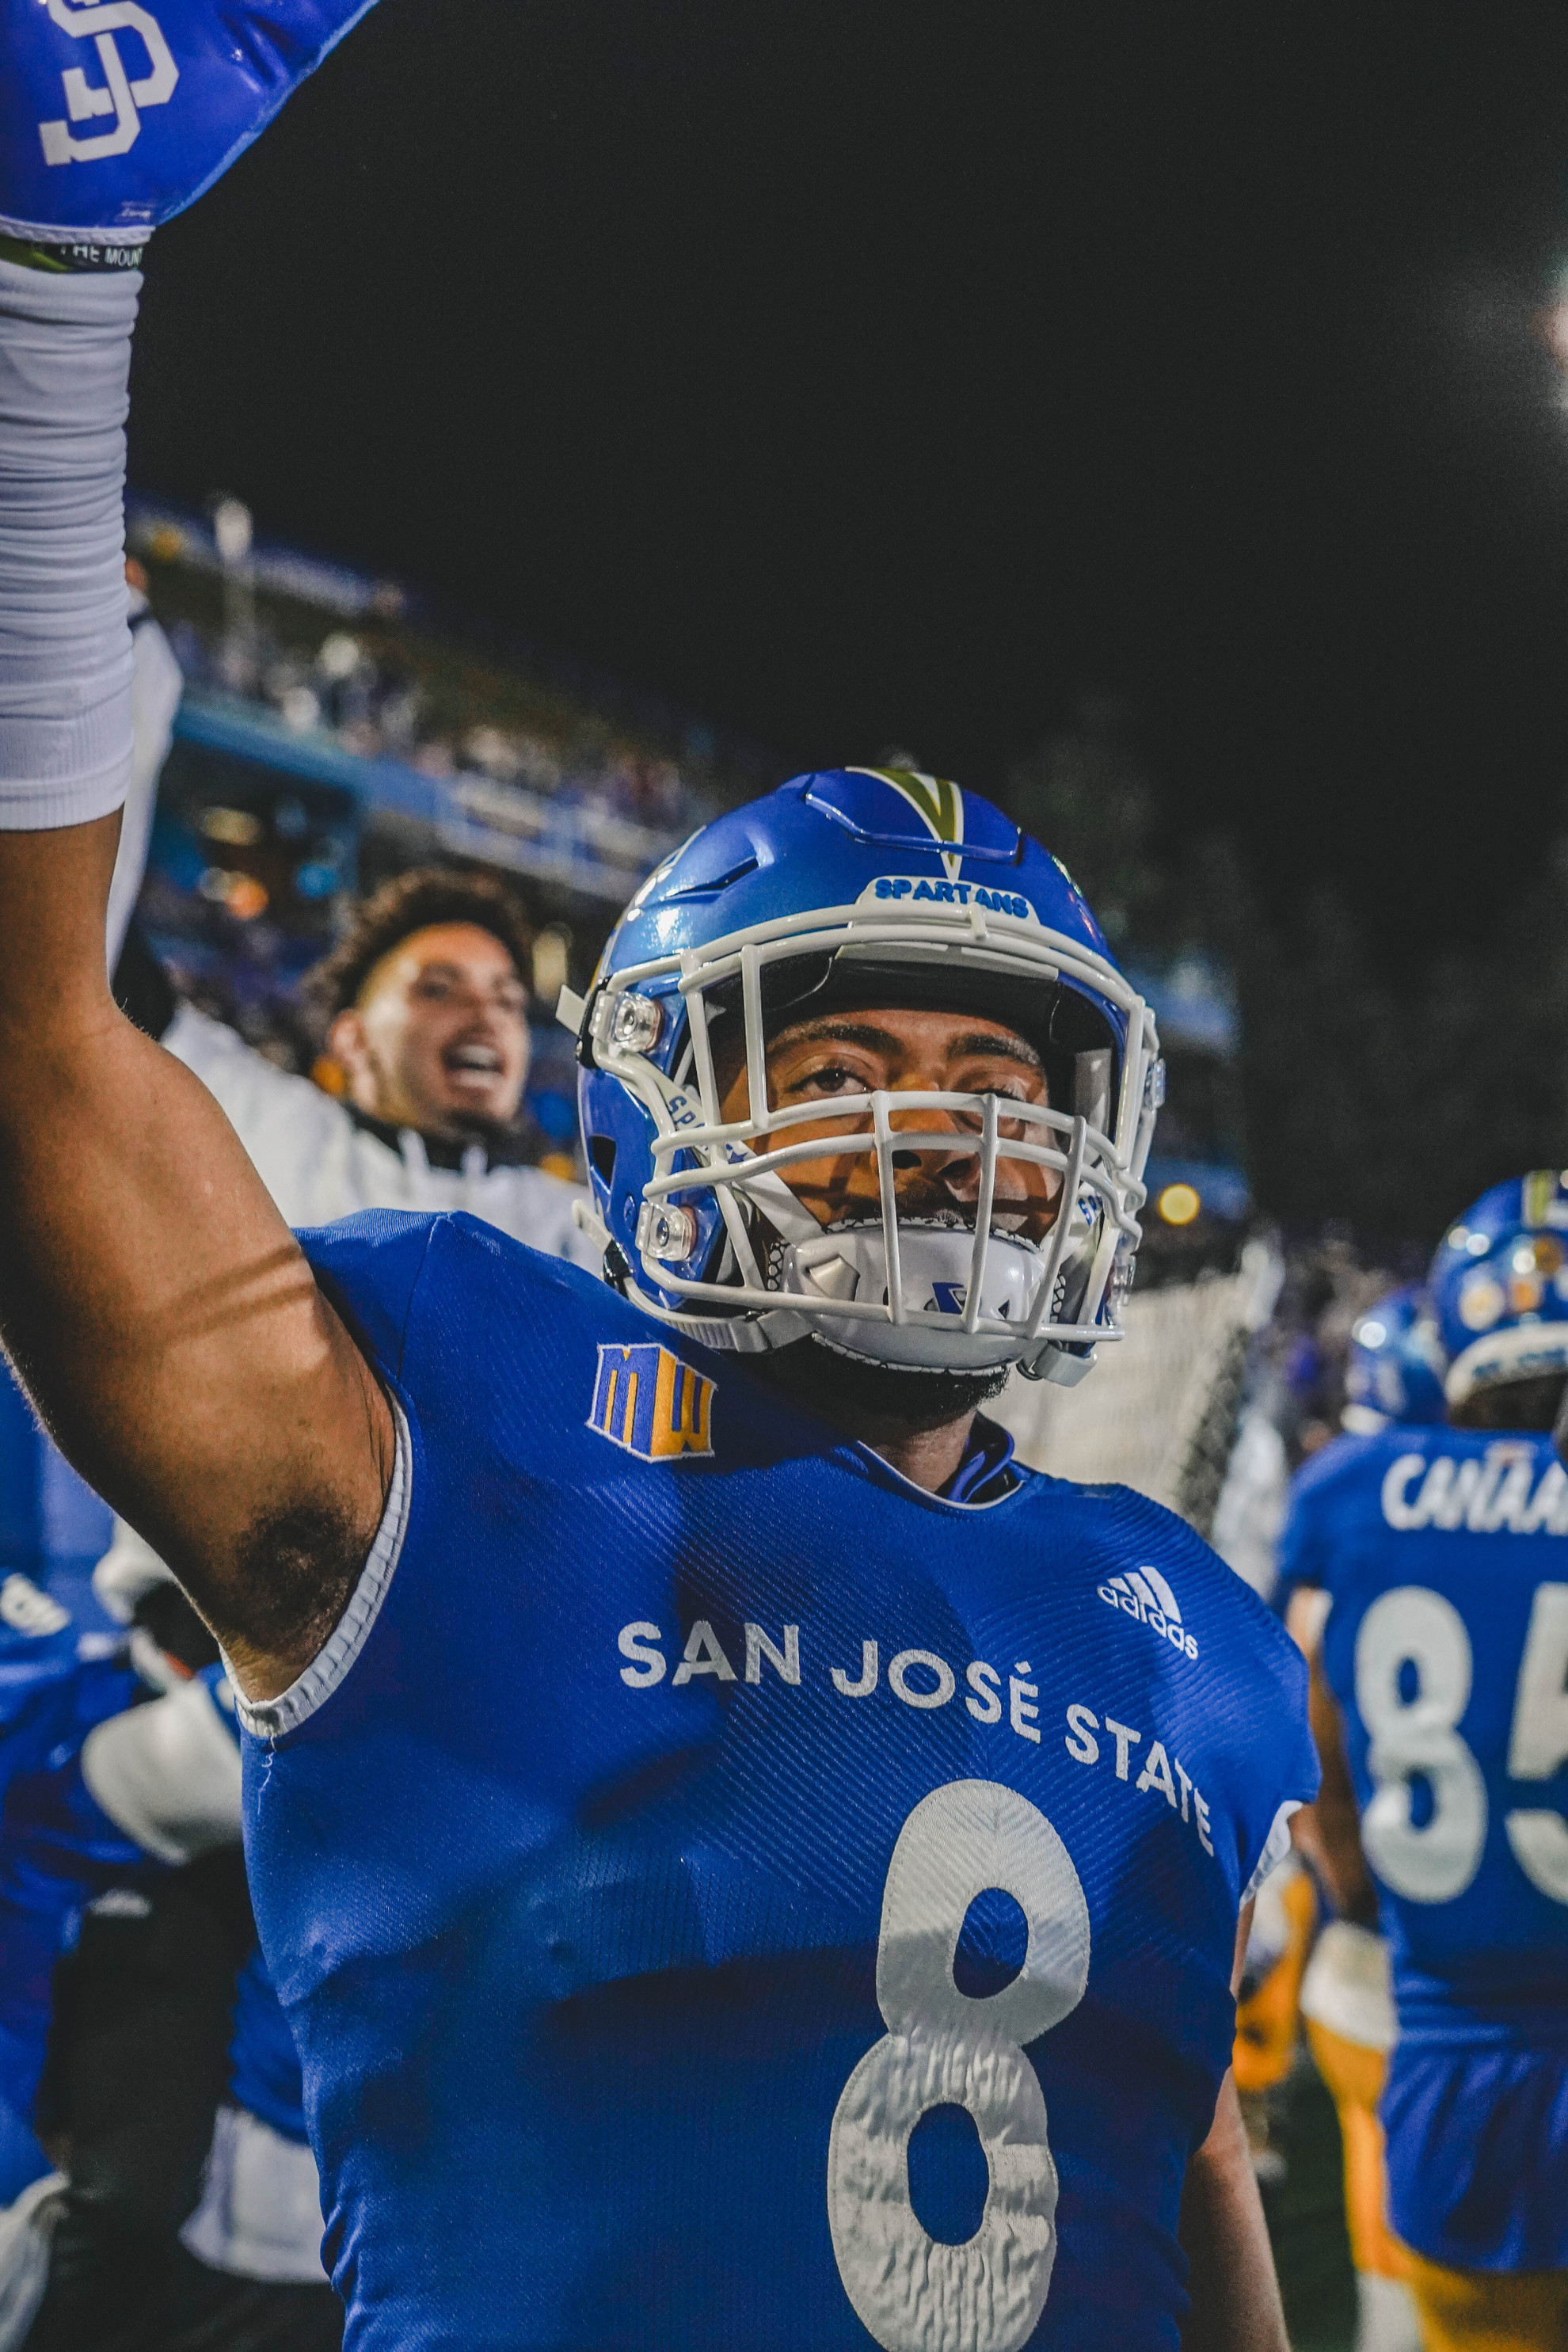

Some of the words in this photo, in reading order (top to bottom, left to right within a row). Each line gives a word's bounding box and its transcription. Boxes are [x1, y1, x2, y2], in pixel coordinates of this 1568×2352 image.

[875, 878, 1029, 919] SPARTANS
[1097, 1585, 1199, 1660] adidas
[617, 1619, 801, 1688] SAN
[831, 1638, 1041, 1744] JOSÉ
[1065, 1703, 1216, 1858] STATE
[827, 1779, 1091, 2352] 8
